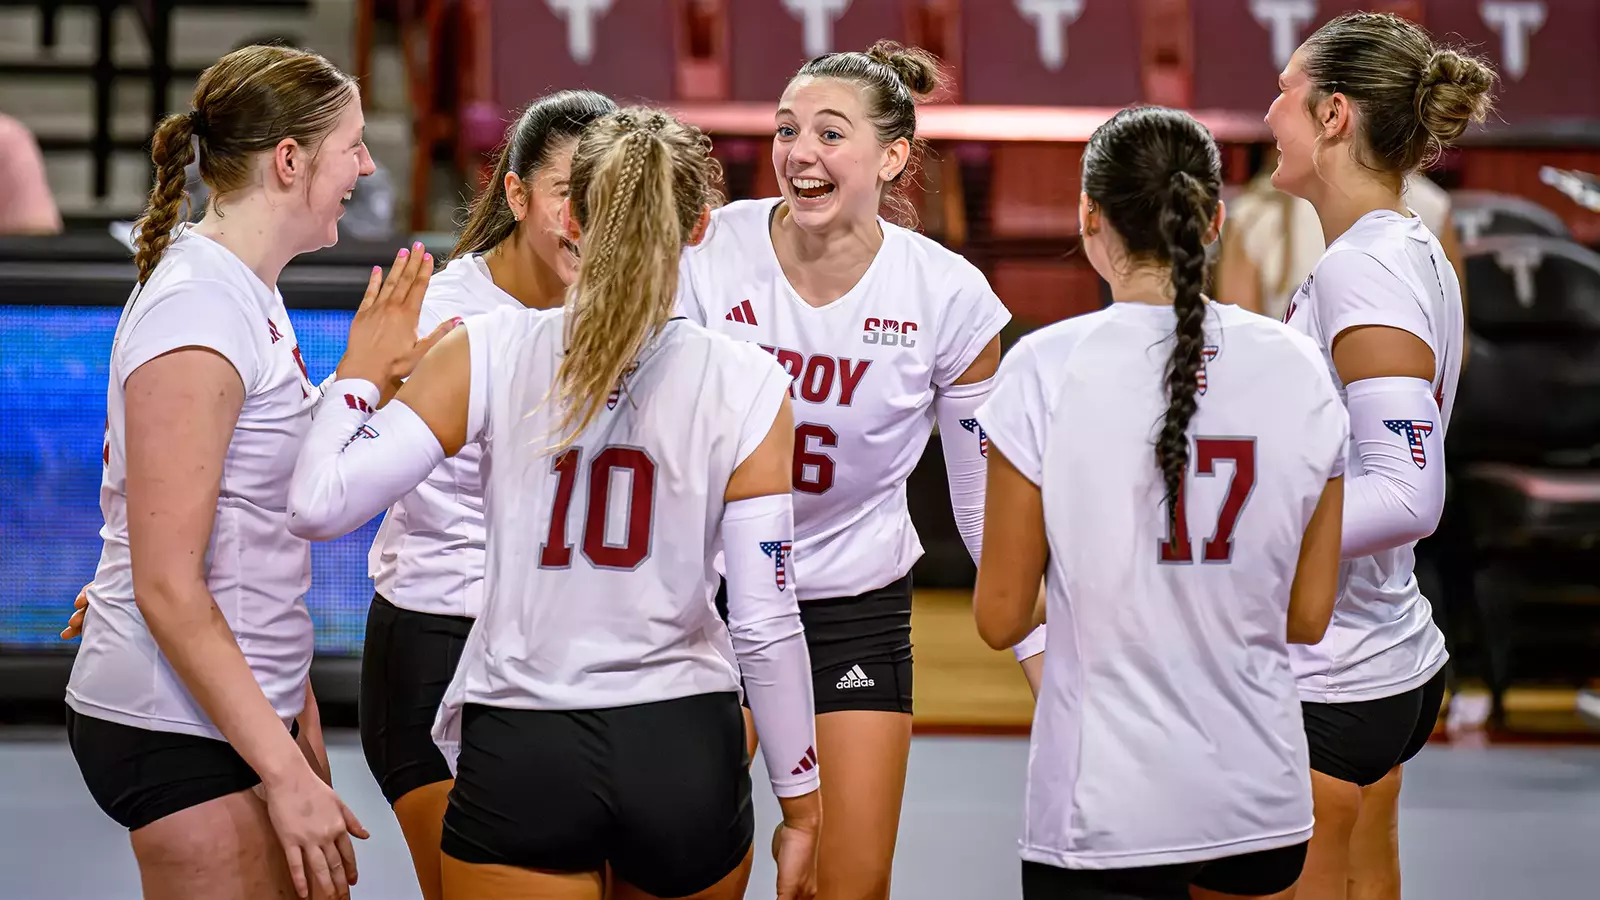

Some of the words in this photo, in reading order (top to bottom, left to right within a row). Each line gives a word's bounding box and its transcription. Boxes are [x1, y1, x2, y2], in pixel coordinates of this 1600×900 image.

[863, 317, 918, 348] SBC
[757, 343, 873, 407] ROY
[792, 421, 839, 495] 6
[537, 444, 659, 572] 10
[1157, 435, 1258, 565] 17
[836, 678, 875, 689] adidas
